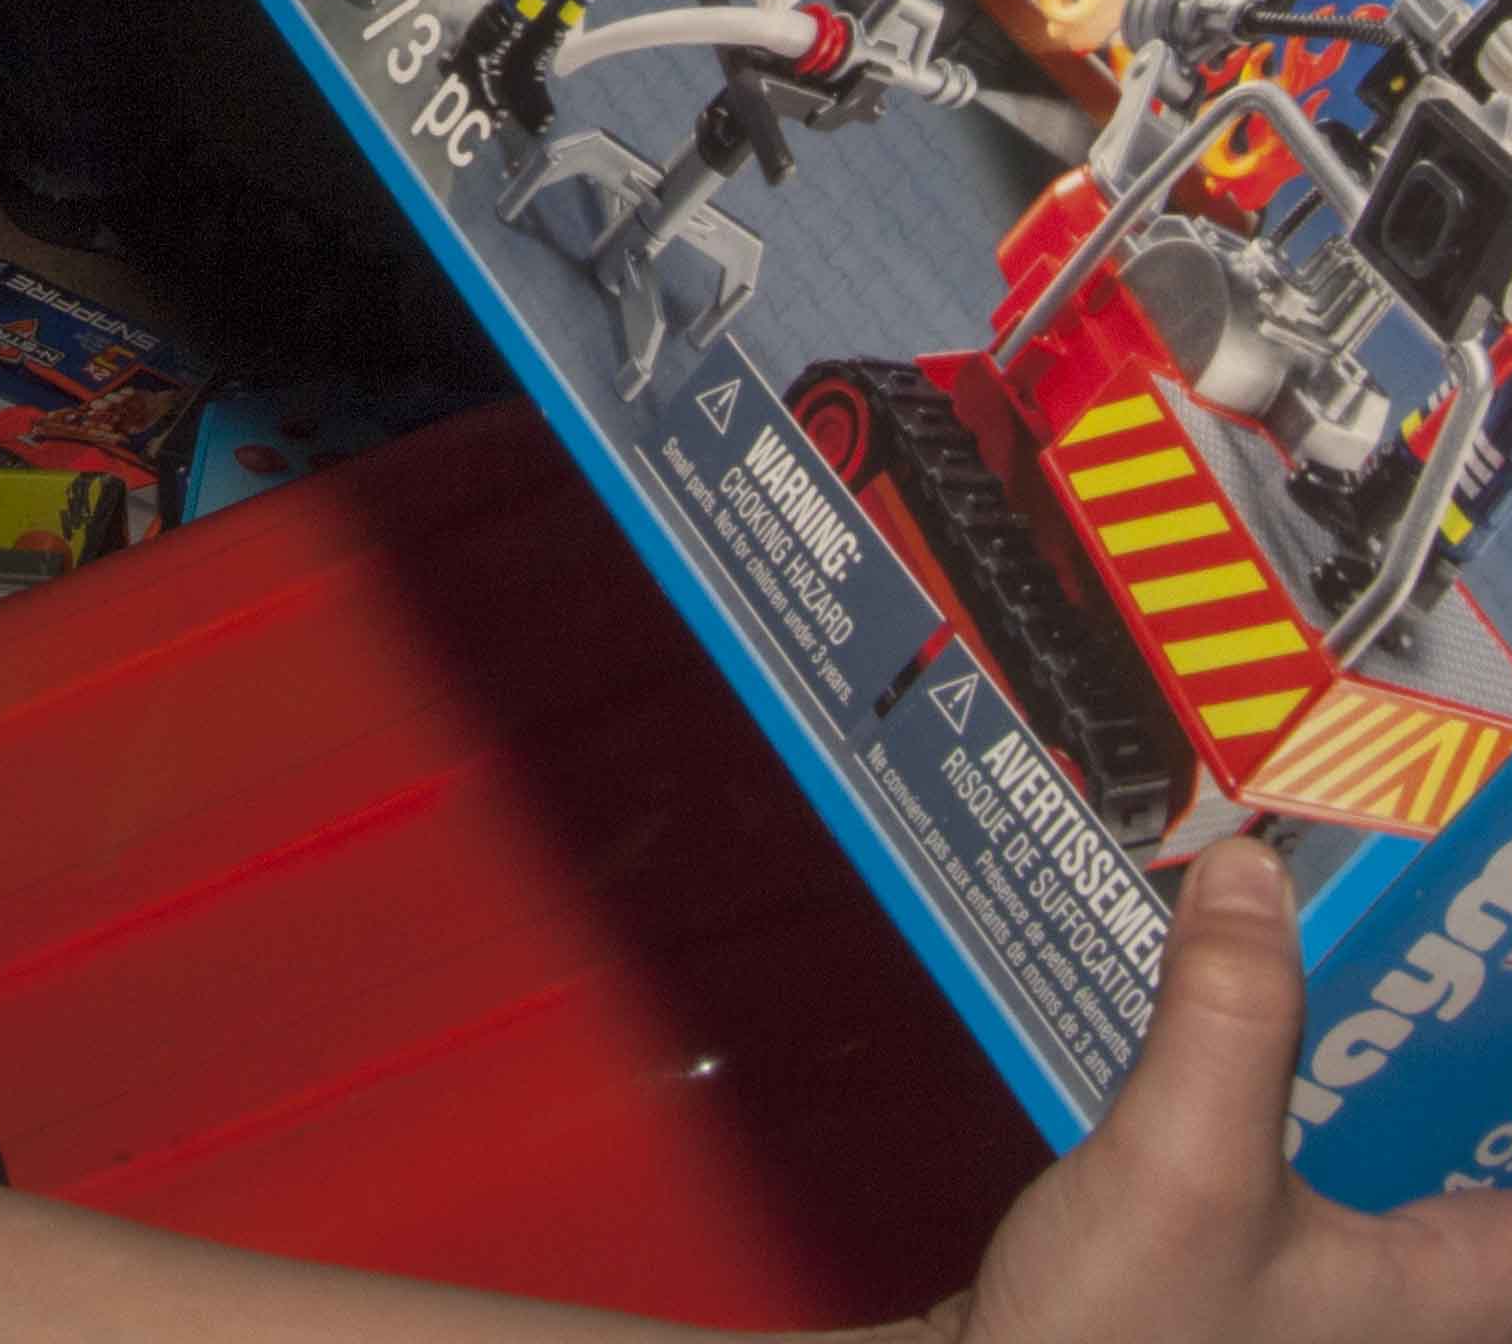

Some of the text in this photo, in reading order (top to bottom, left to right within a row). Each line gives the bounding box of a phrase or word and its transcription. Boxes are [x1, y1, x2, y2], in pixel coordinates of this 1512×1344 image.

[411, 83, 491, 167] pc
[2, 273, 160, 352] SNAPFIRE
[661, 436, 853, 705] Small parts. Not for children under 3 years.
[720, 466, 853, 645] CHOKING HAZARD
[746, 426, 860, 579] WARNING:
[941, 747, 1015, 843] RISQUE
[1002, 831, 1041, 878] DE
[983, 732, 1166, 985] AVERTISSEMEN
[866, 742, 1113, 1090] Ne convient pas aux enfants de moins de 3 ans.
[975, 849, 1132, 1069] Présence de petits éléments.
